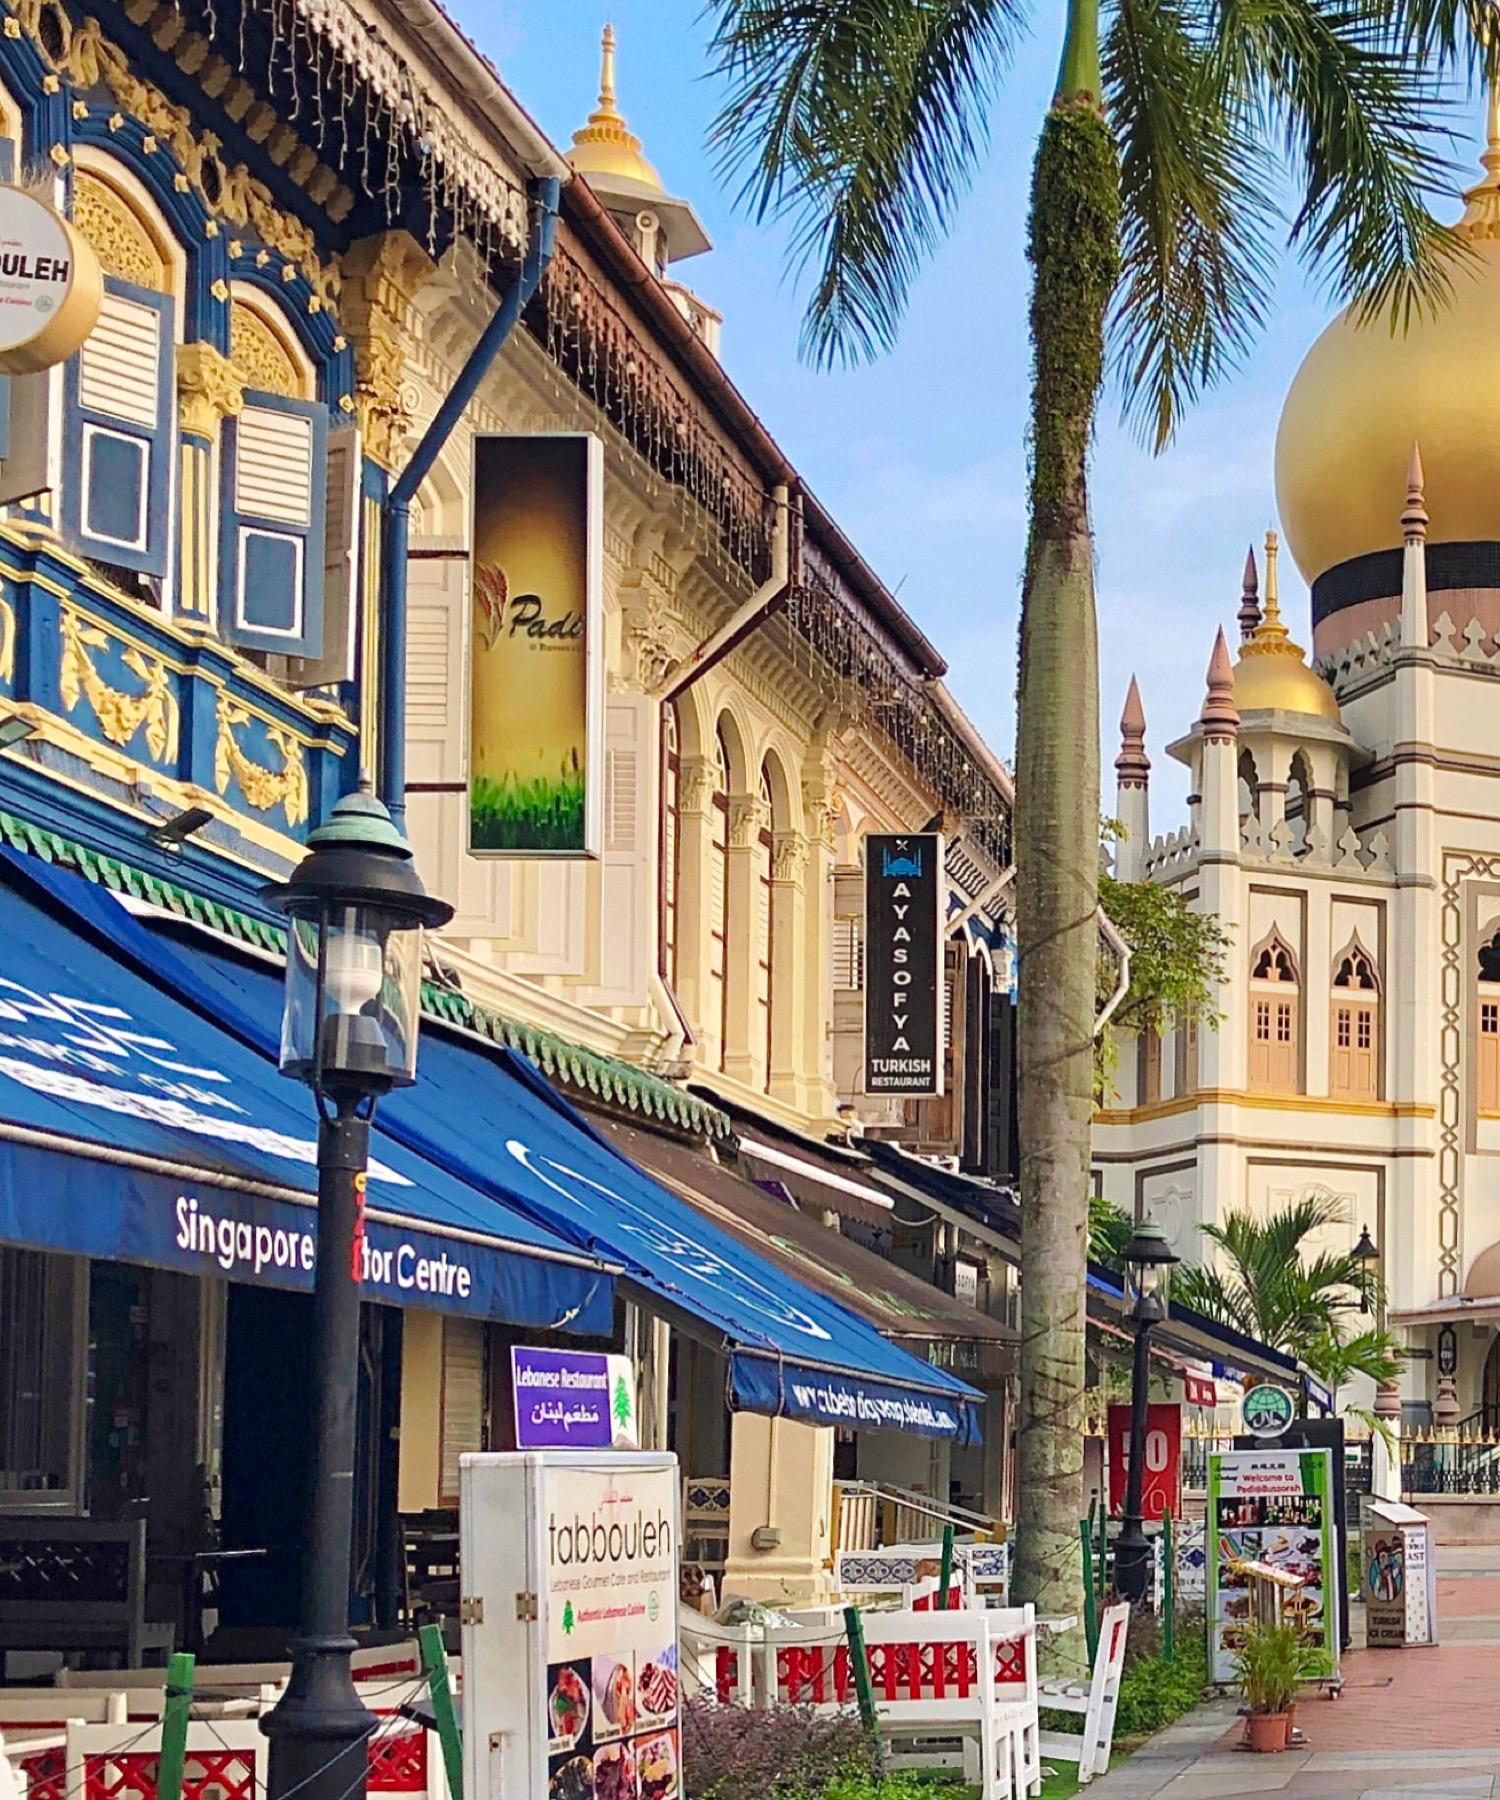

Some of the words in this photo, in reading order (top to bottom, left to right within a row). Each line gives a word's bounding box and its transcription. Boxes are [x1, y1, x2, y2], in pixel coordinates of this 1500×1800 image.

[892, 882, 912, 1051] AYASOFYA
[872, 1059, 931, 1073] TURKISH
[872, 1077, 931, 1087] RESTAURANT
[176, 1197, 315, 1273] Singapore
[397, 1244, 471, 1298] Centre
[517, 1365, 559, 1387] Lebanese
[561, 1368, 607, 1389] Restaurant
[1242, 1473, 1282, 1482] Welcome
[1284, 1474, 1294, 1482] to
[549, 1508, 670, 1566] tabbouleh
